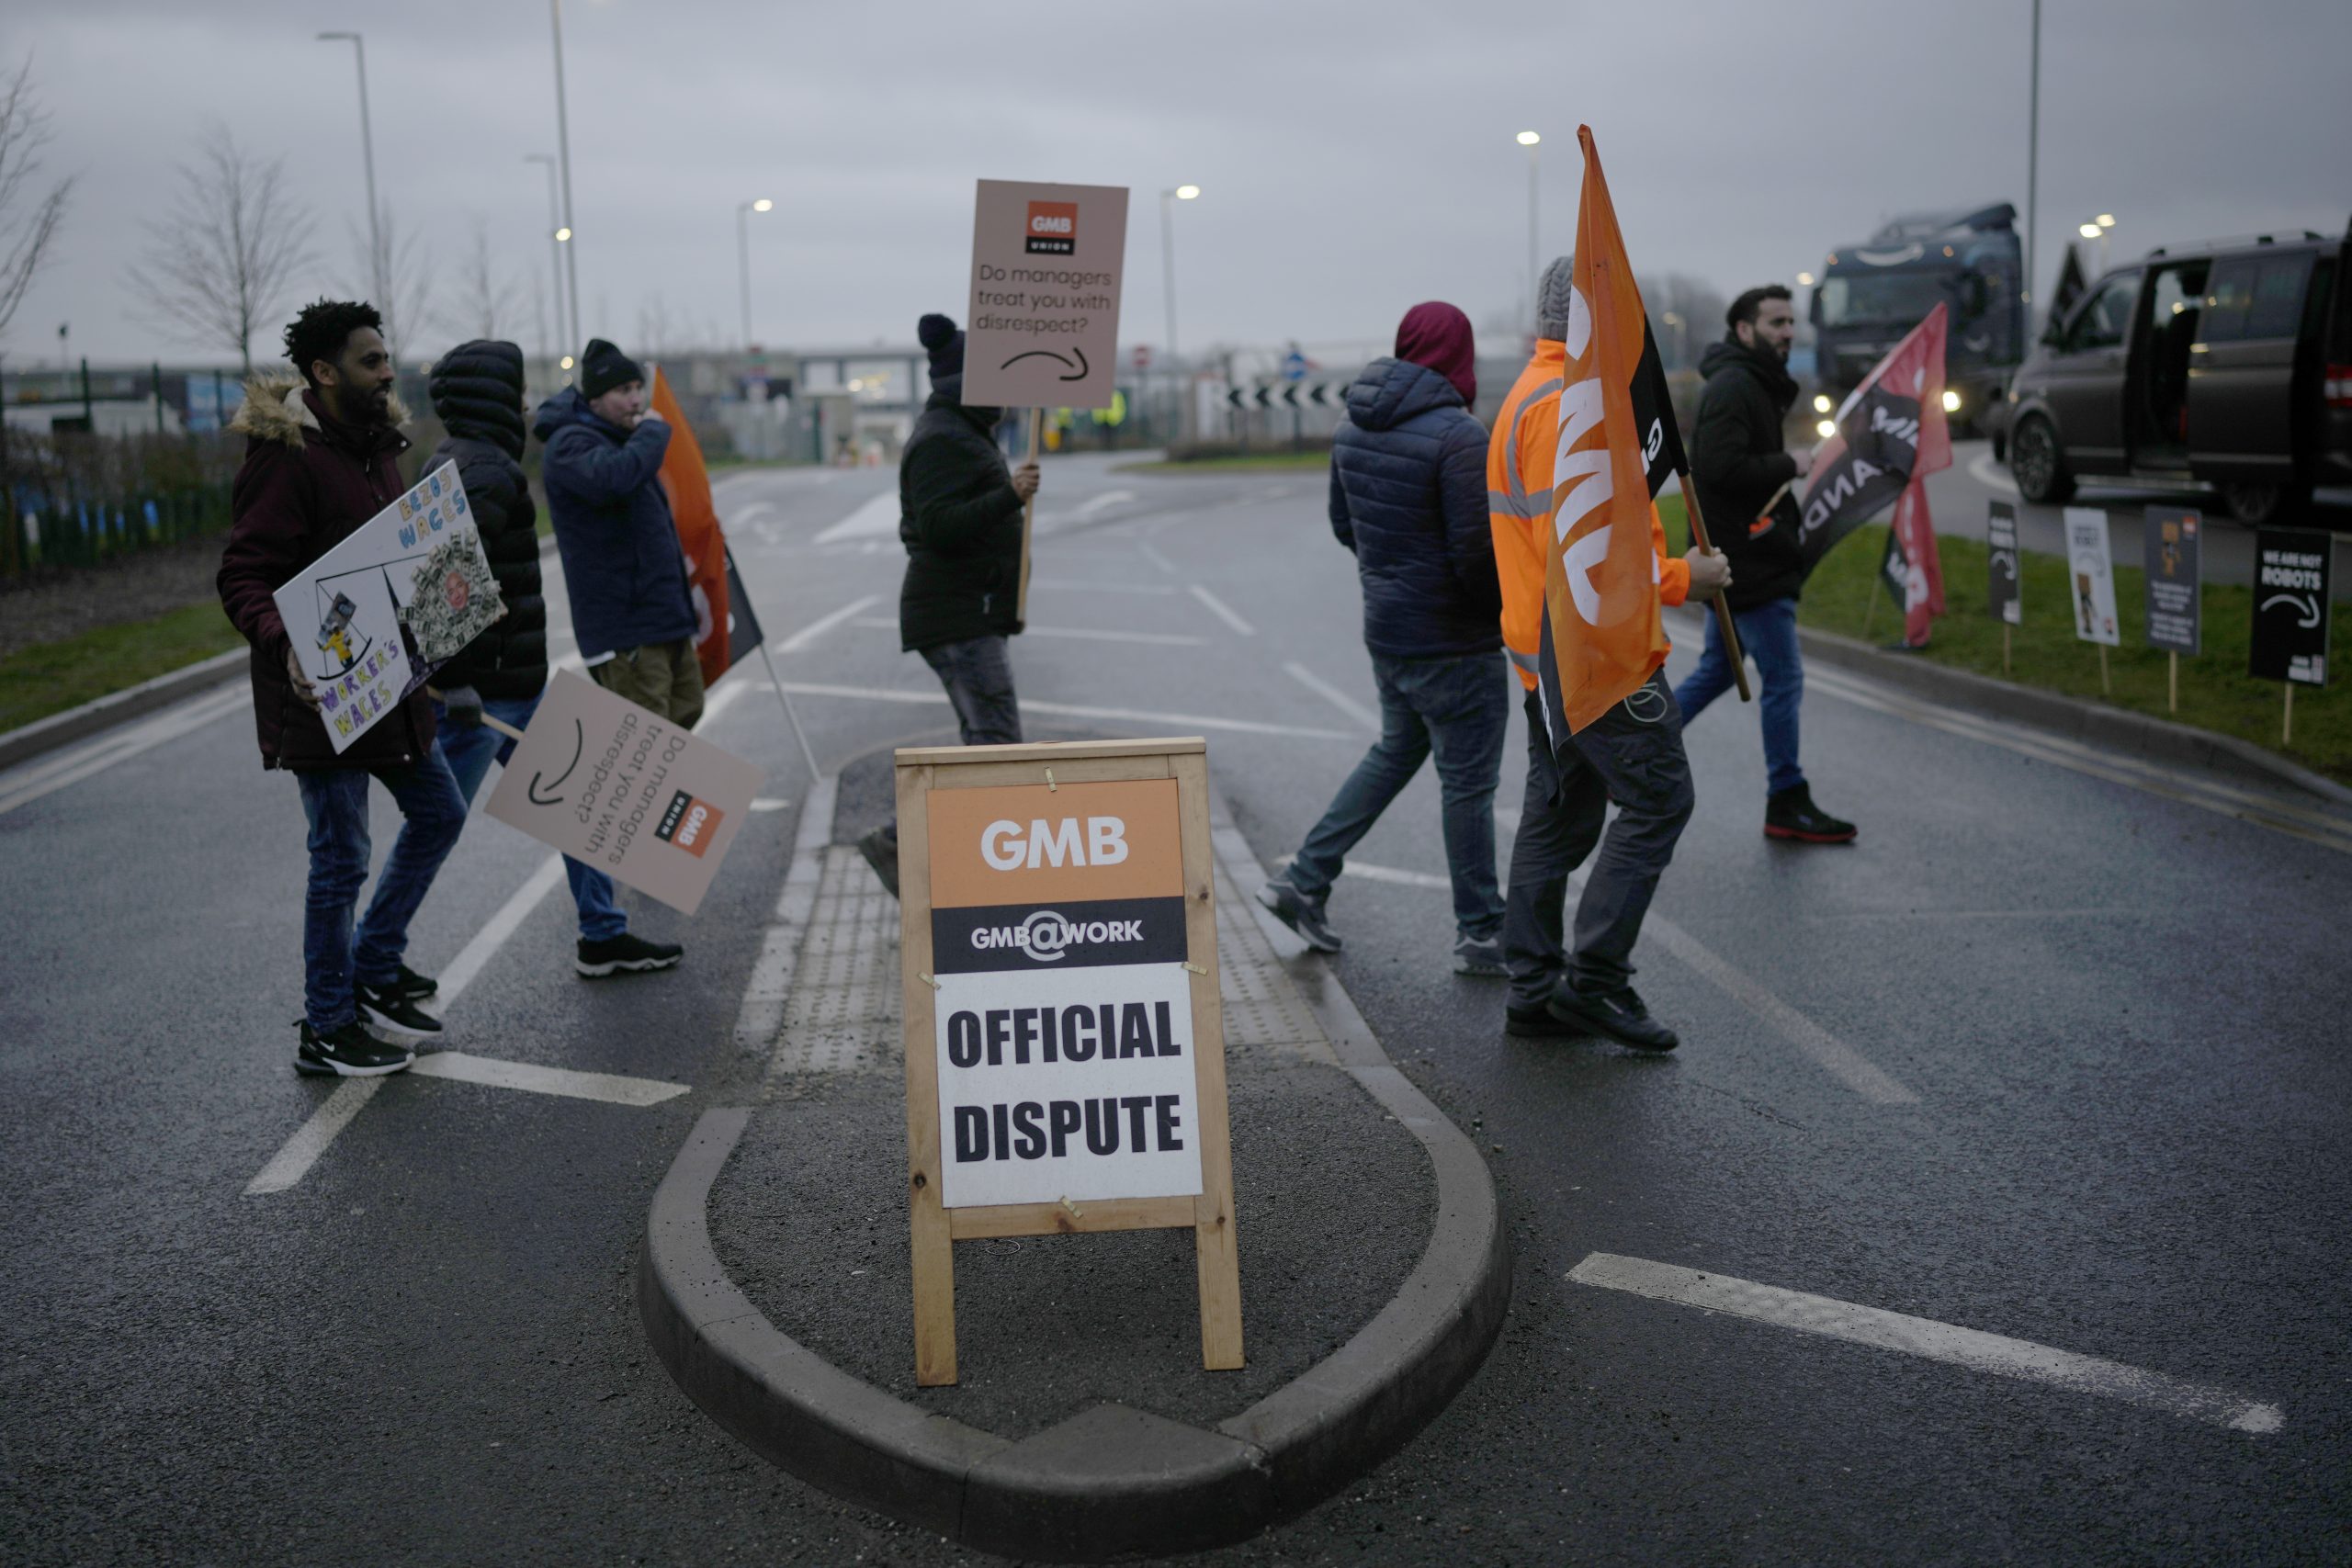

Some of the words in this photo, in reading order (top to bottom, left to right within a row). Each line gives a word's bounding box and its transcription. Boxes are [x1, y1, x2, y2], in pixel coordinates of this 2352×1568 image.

[1032, 215, 1072, 233] GMB
[1030, 242, 1070, 251] UNION
[979, 265, 1007, 282] Do
[1012, 266, 1113, 290] managers
[978, 289, 1025, 308] treat
[1030, 294, 1066, 312] you
[1069, 293, 1112, 310] with
[976, 313, 1090, 337] disrespect?
[399, 468, 453, 522] BEZOS
[398, 490, 467, 549] WAGES
[2261, 566, 2323, 591] ROBOTS
[321, 639, 400, 713] WORKER'S
[334, 682, 393, 739] WAGES
[574, 712, 635, 823] disrespect?
[629, 725, 663, 772] treat
[662, 736, 686, 764] Do
[608, 772, 638, 811] you
[585, 813, 616, 855] with
[608, 768, 668, 865] managers
[662, 796, 687, 836] UNION
[678, 806, 708, 847] GMB
[980, 816, 1129, 872] GMB
[970, 909, 1145, 962] GMB@WORK
[947, 1000, 1182, 1068] OFFICIAL
[954, 1094, 1184, 1164] DISPUTE
